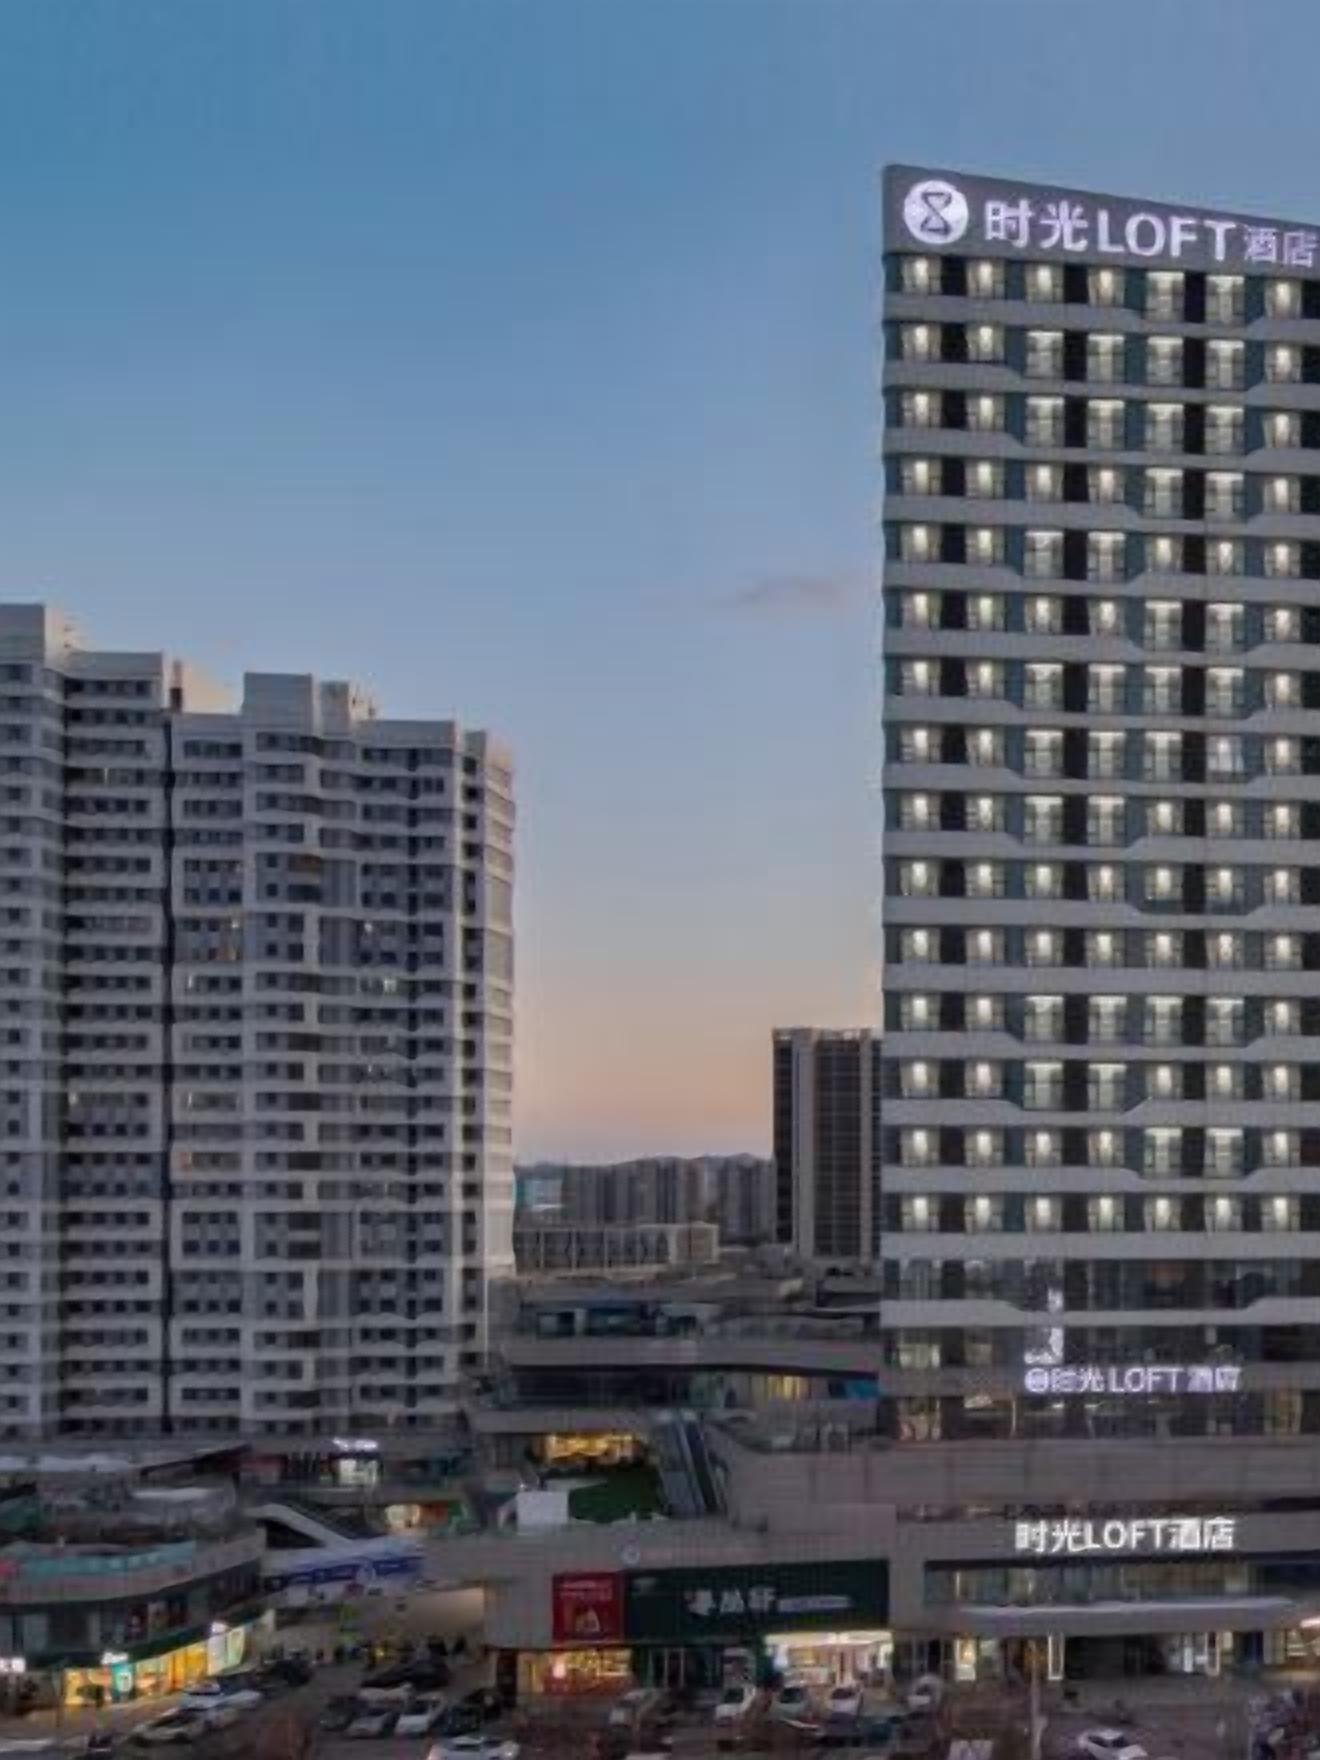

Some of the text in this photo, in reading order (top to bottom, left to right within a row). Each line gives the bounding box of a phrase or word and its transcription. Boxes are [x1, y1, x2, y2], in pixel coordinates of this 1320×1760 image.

[984, 199, 1318, 267] 时光LOFT酒店
[1015, 1517, 1235, 1551] 时光LOFT酒店
